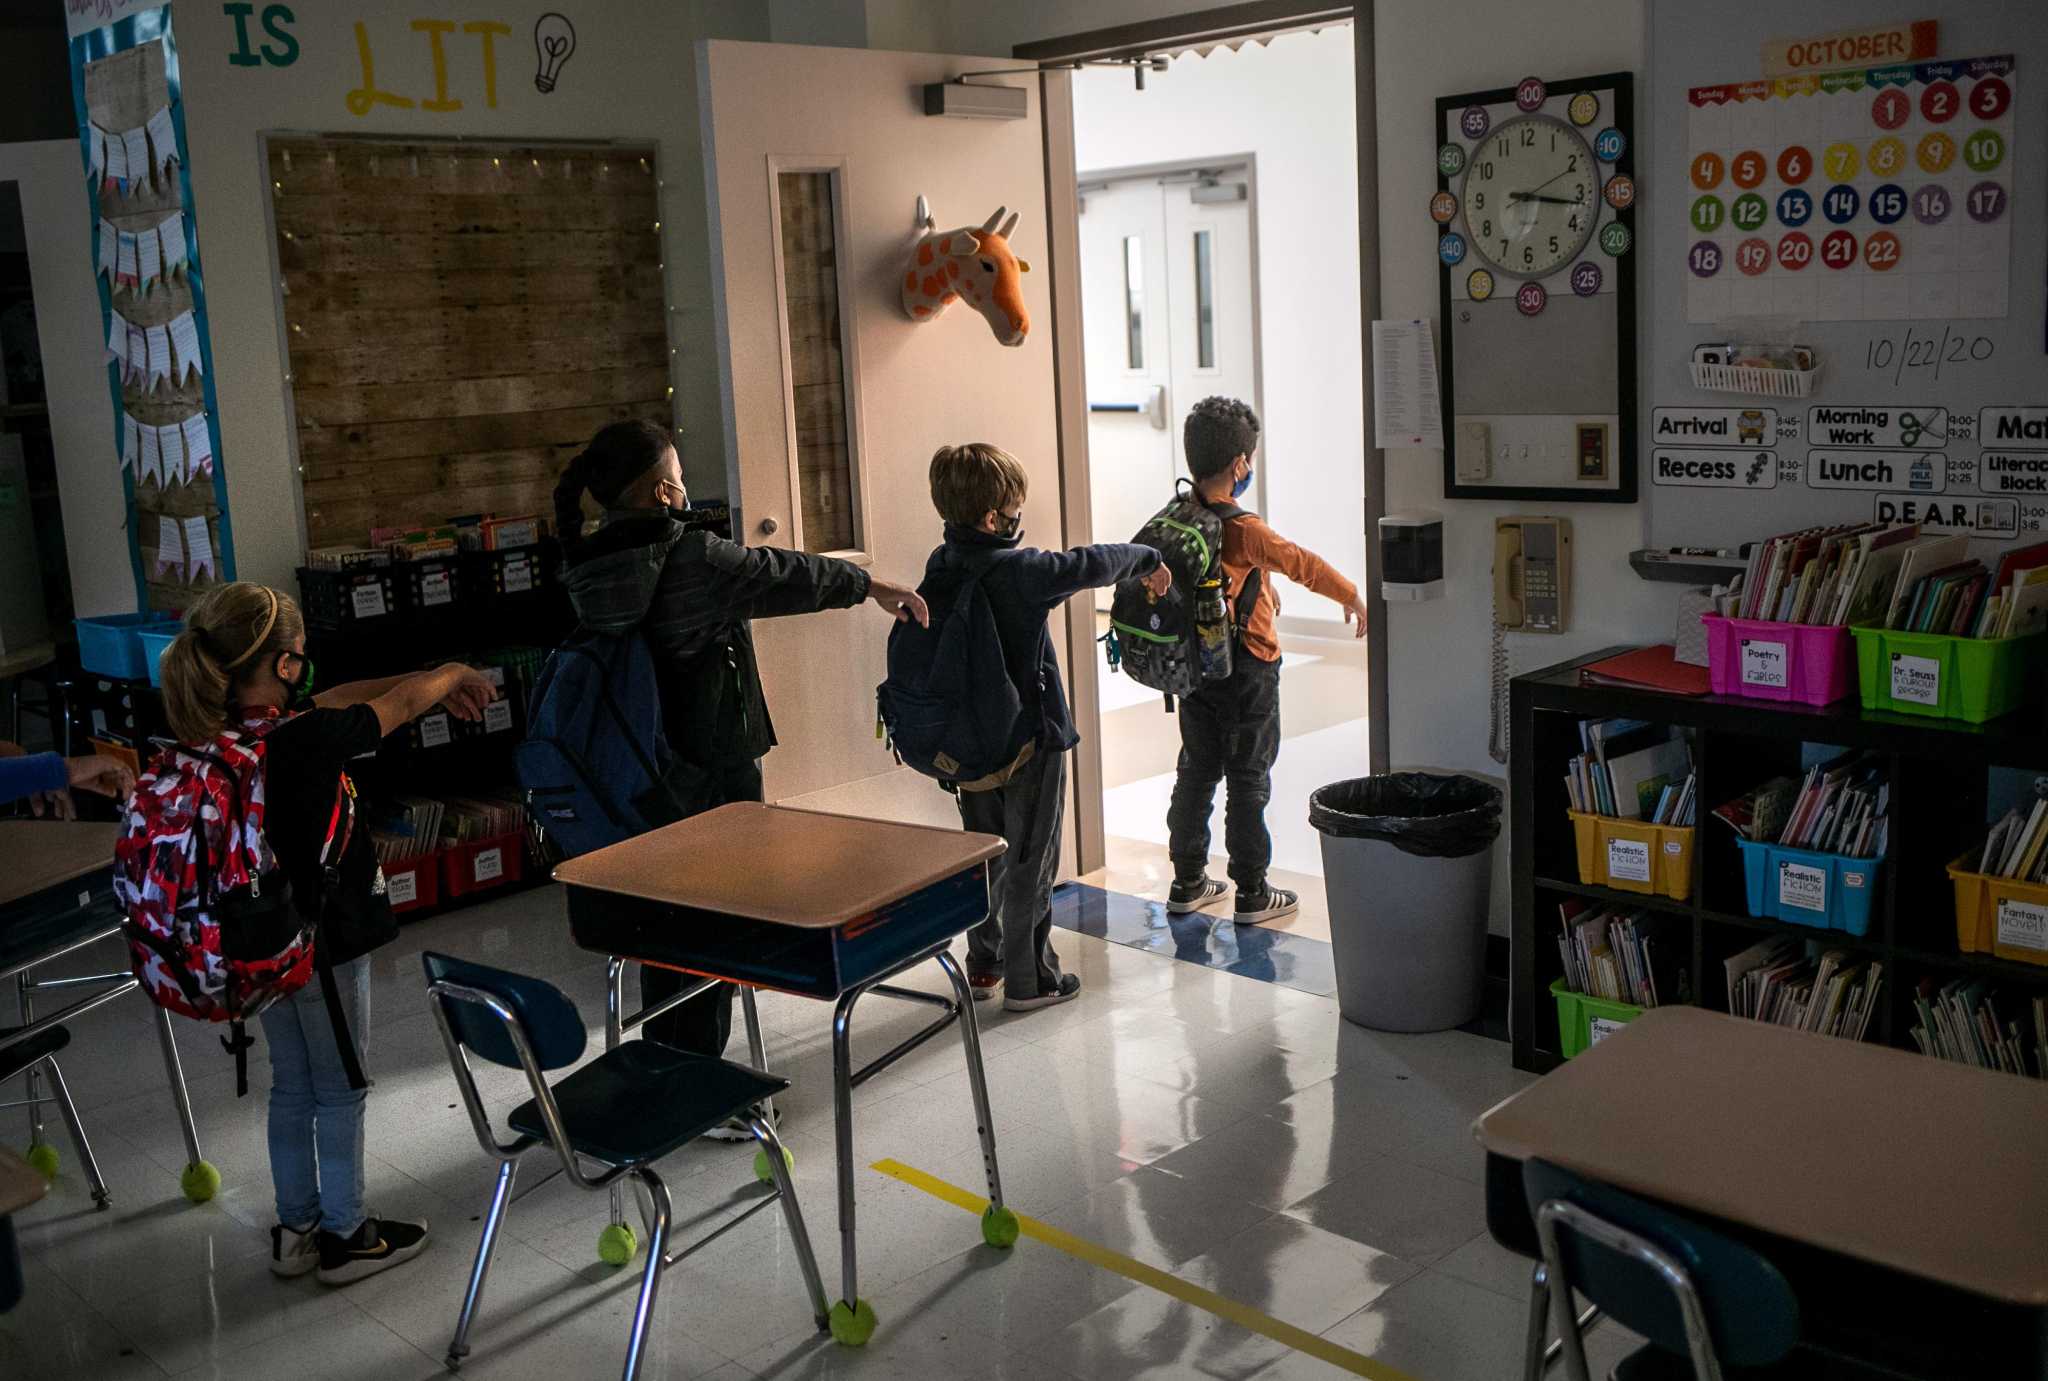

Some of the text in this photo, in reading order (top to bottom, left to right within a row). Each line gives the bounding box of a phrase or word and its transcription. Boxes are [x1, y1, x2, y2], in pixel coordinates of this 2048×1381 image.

[223, 2, 300, 67] IS
[1787, 31, 1905, 67] OCTOBER
[346, 20, 512, 116] LIT
[1873, 70, 1911, 82] Thursday
[1927, 65, 1953, 77] Friday
[1971, 60, 2009, 72] Saturday
[1519, 86, 1541, 102] :00
[1886, 88, 1998, 121] 1 2 3
[1466, 114, 1484, 130] :55
[1521, 128, 1535, 147] 12
[1551, 133, 1555, 152] 1
[1599, 136, 1620, 153] :10
[1499, 139, 1510, 157] 11
[1567, 154, 1577, 173] 2
[1700, 139, 1998, 182] 4 5 6 7 8 9 10
[1480, 161, 1493, 180] 10
[1576, 183, 1585, 201] 3
[1611, 183, 1631, 199] :15
[1475, 192, 1485, 210] 9
[1698, 189, 1999, 224] 11 12 13 14 15 16 17
[1482, 220, 1492, 237] 8
[1568, 214, 1578, 232] 4
[1500, 239, 1509, 257] 7
[1549, 235, 1559, 253] 5
[1524, 246, 1533, 264] 6
[1693, 239, 1897, 270] 18 19 20 21 22
[1577, 271, 1596, 287] :25
[1521, 290, 1540, 307] :30
[1866, 326, 1995, 387] 10/22/20
[1658, 416, 1728, 435] Arrival
[1816, 408, 1889, 428] Morning
[1829, 428, 1875, 445] Work
[1658, 456, 1736, 480] Recess
[1820, 459, 1893, 483] Lunch
[1989, 455, 2048, 472] Literac
[2000, 475, 2047, 491] Block
[1878, 501, 1974, 528] D.EA.R.
[2022, 520, 2040, 530] 3:15
[1748, 648, 1780, 662] Poetry
[1909, 668, 1936, 681] Seuss
[1611, 845, 1645, 856] Realistic
[1783, 869, 1821, 884] Realistic
[2003, 907, 2044, 922] Fantasy
